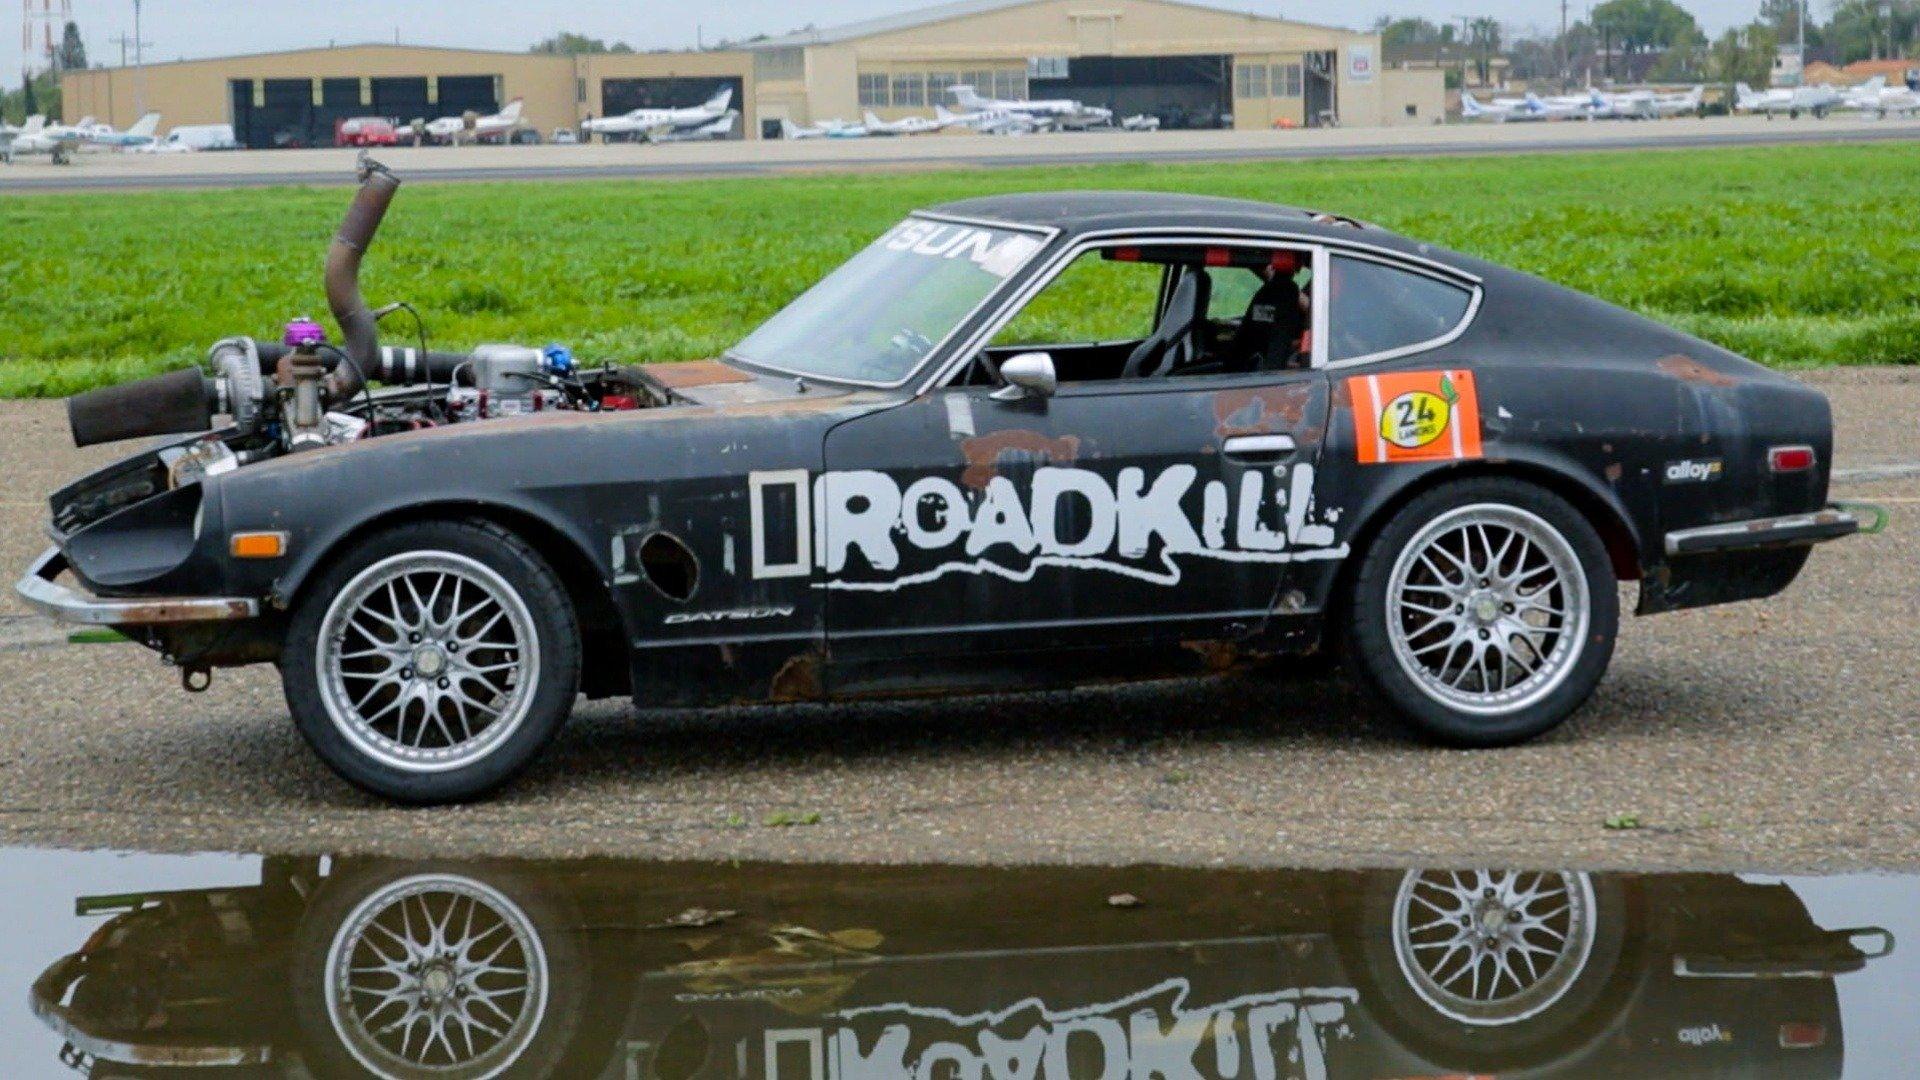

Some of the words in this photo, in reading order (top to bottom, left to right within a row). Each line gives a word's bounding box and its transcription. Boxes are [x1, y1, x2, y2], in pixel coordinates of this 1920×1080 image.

[1397, 396, 1434, 427] 24
[813, 463, 1338, 573] ROADKILL
[663, 606, 795, 624] DATSUN
